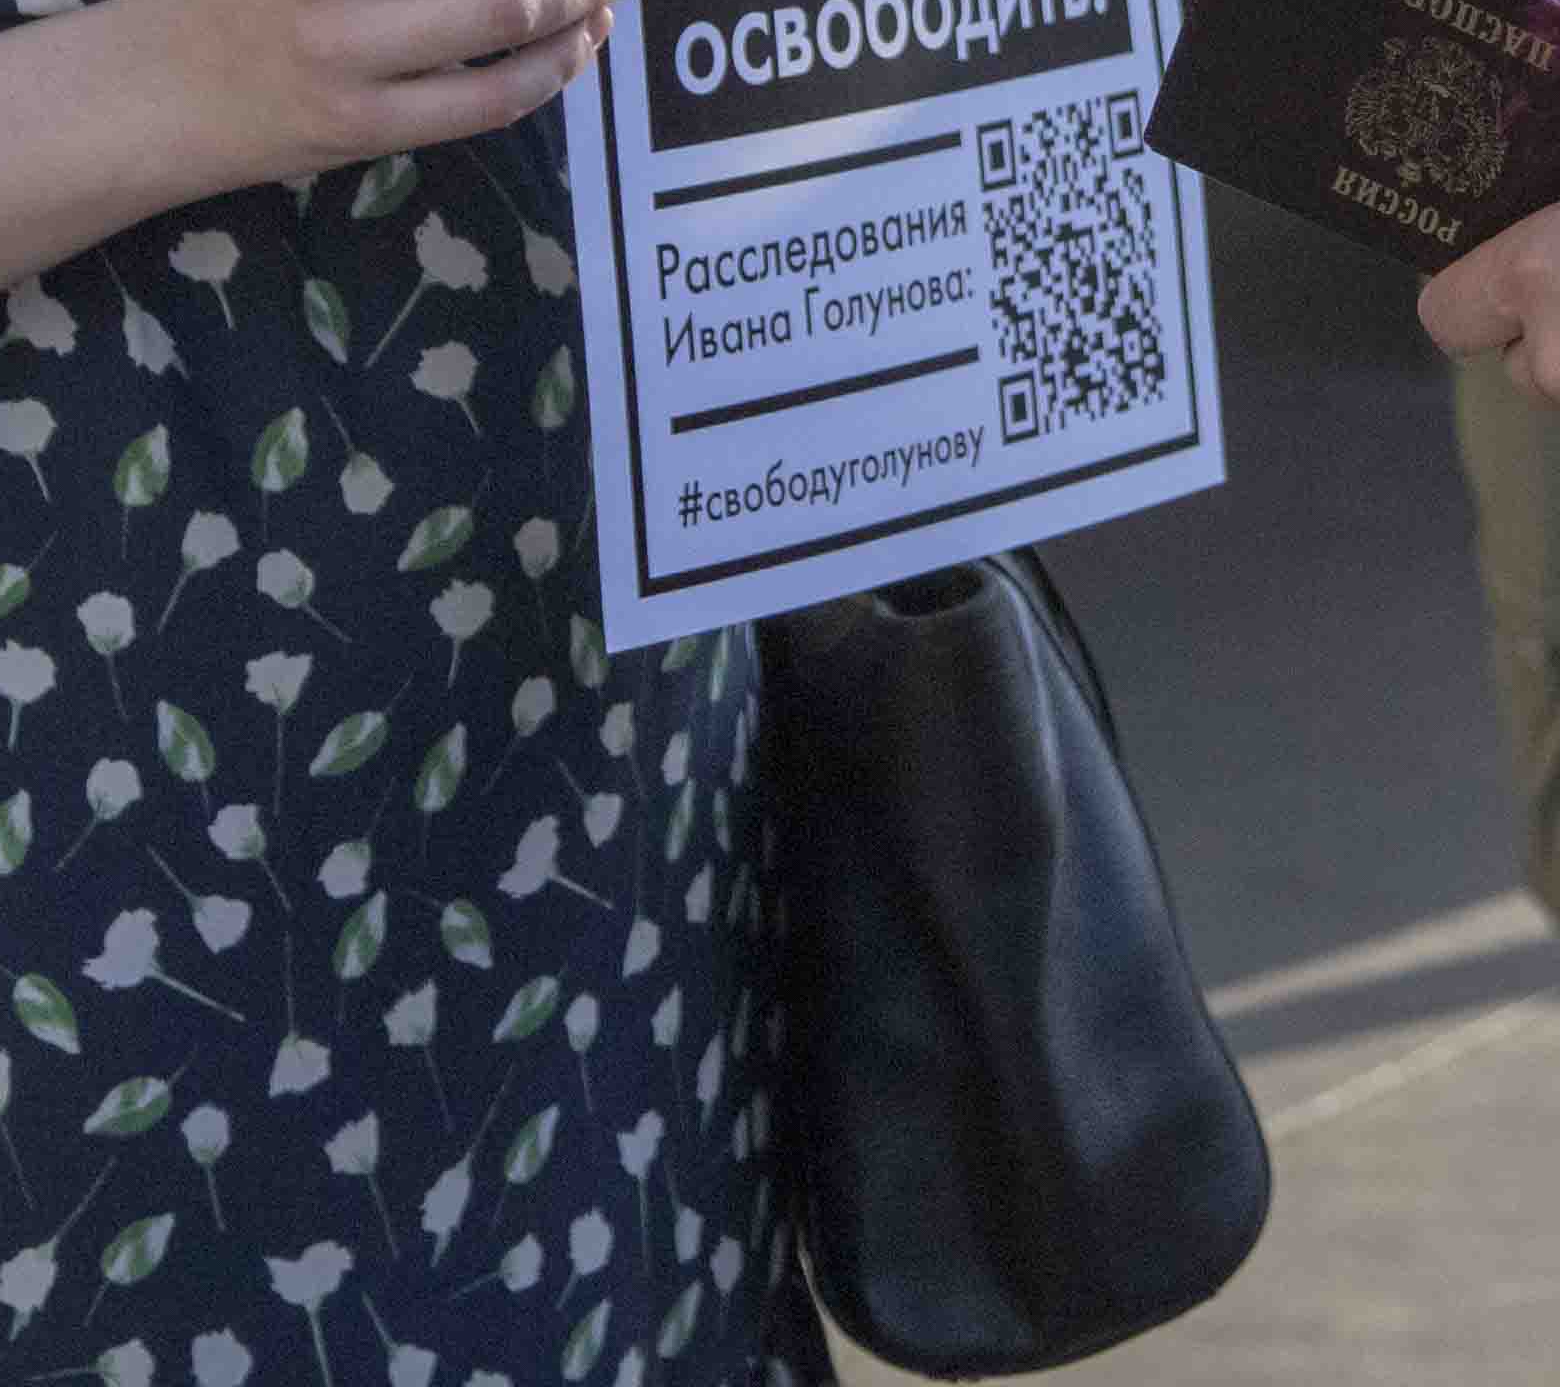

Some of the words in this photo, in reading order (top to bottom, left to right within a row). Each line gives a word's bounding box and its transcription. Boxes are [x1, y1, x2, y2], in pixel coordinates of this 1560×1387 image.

[654, 197, 967, 301] Расследования
[1330, 163, 1463, 248] РОССИЯ
[664, 310, 792, 368] Ивана
[802, 265, 974, 338] Голунова:
[677, 424, 986, 529] #свободуголунову
